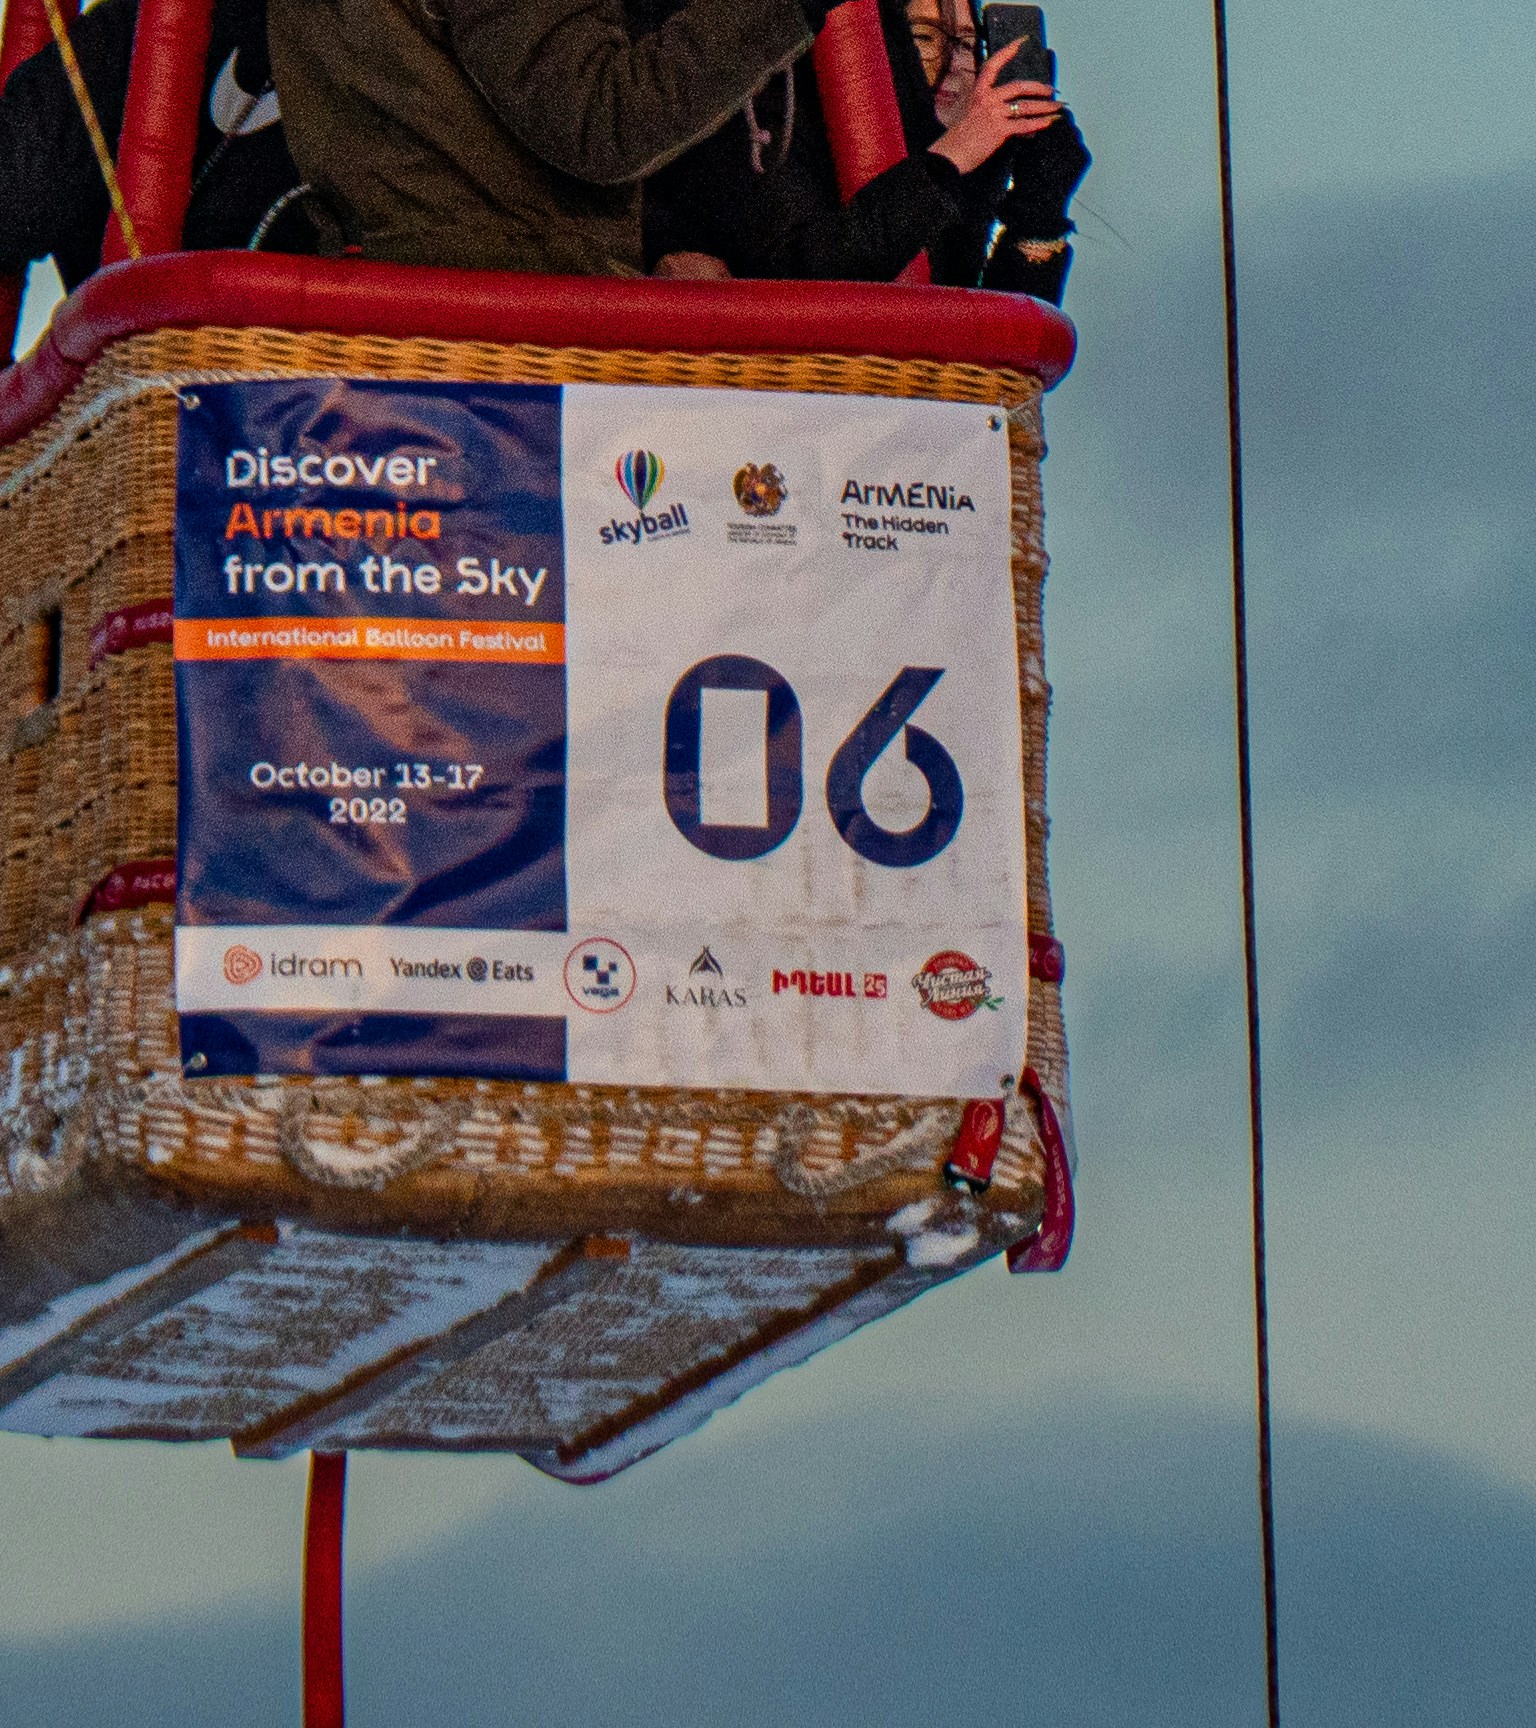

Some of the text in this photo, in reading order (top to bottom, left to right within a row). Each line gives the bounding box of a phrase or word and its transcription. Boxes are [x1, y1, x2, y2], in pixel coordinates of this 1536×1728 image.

[226, 447, 438, 489] Discover
[225, 502, 443, 541] Armenia
[599, 502, 690, 545] skyball
[841, 513, 949, 535] The Hidden
[842, 532, 899, 551] Track
[223, 554, 547, 606] from the Sky
[207, 627, 546, 652] International Balloon Festival
[663, 653, 965, 867] 06
[249, 761, 484, 791] October 13-17
[329, 797, 407, 824] 2022
[270, 952, 364, 979] idram
[389, 957, 534, 981] Yandex Eats
[665, 985, 748, 1008] KARAS
